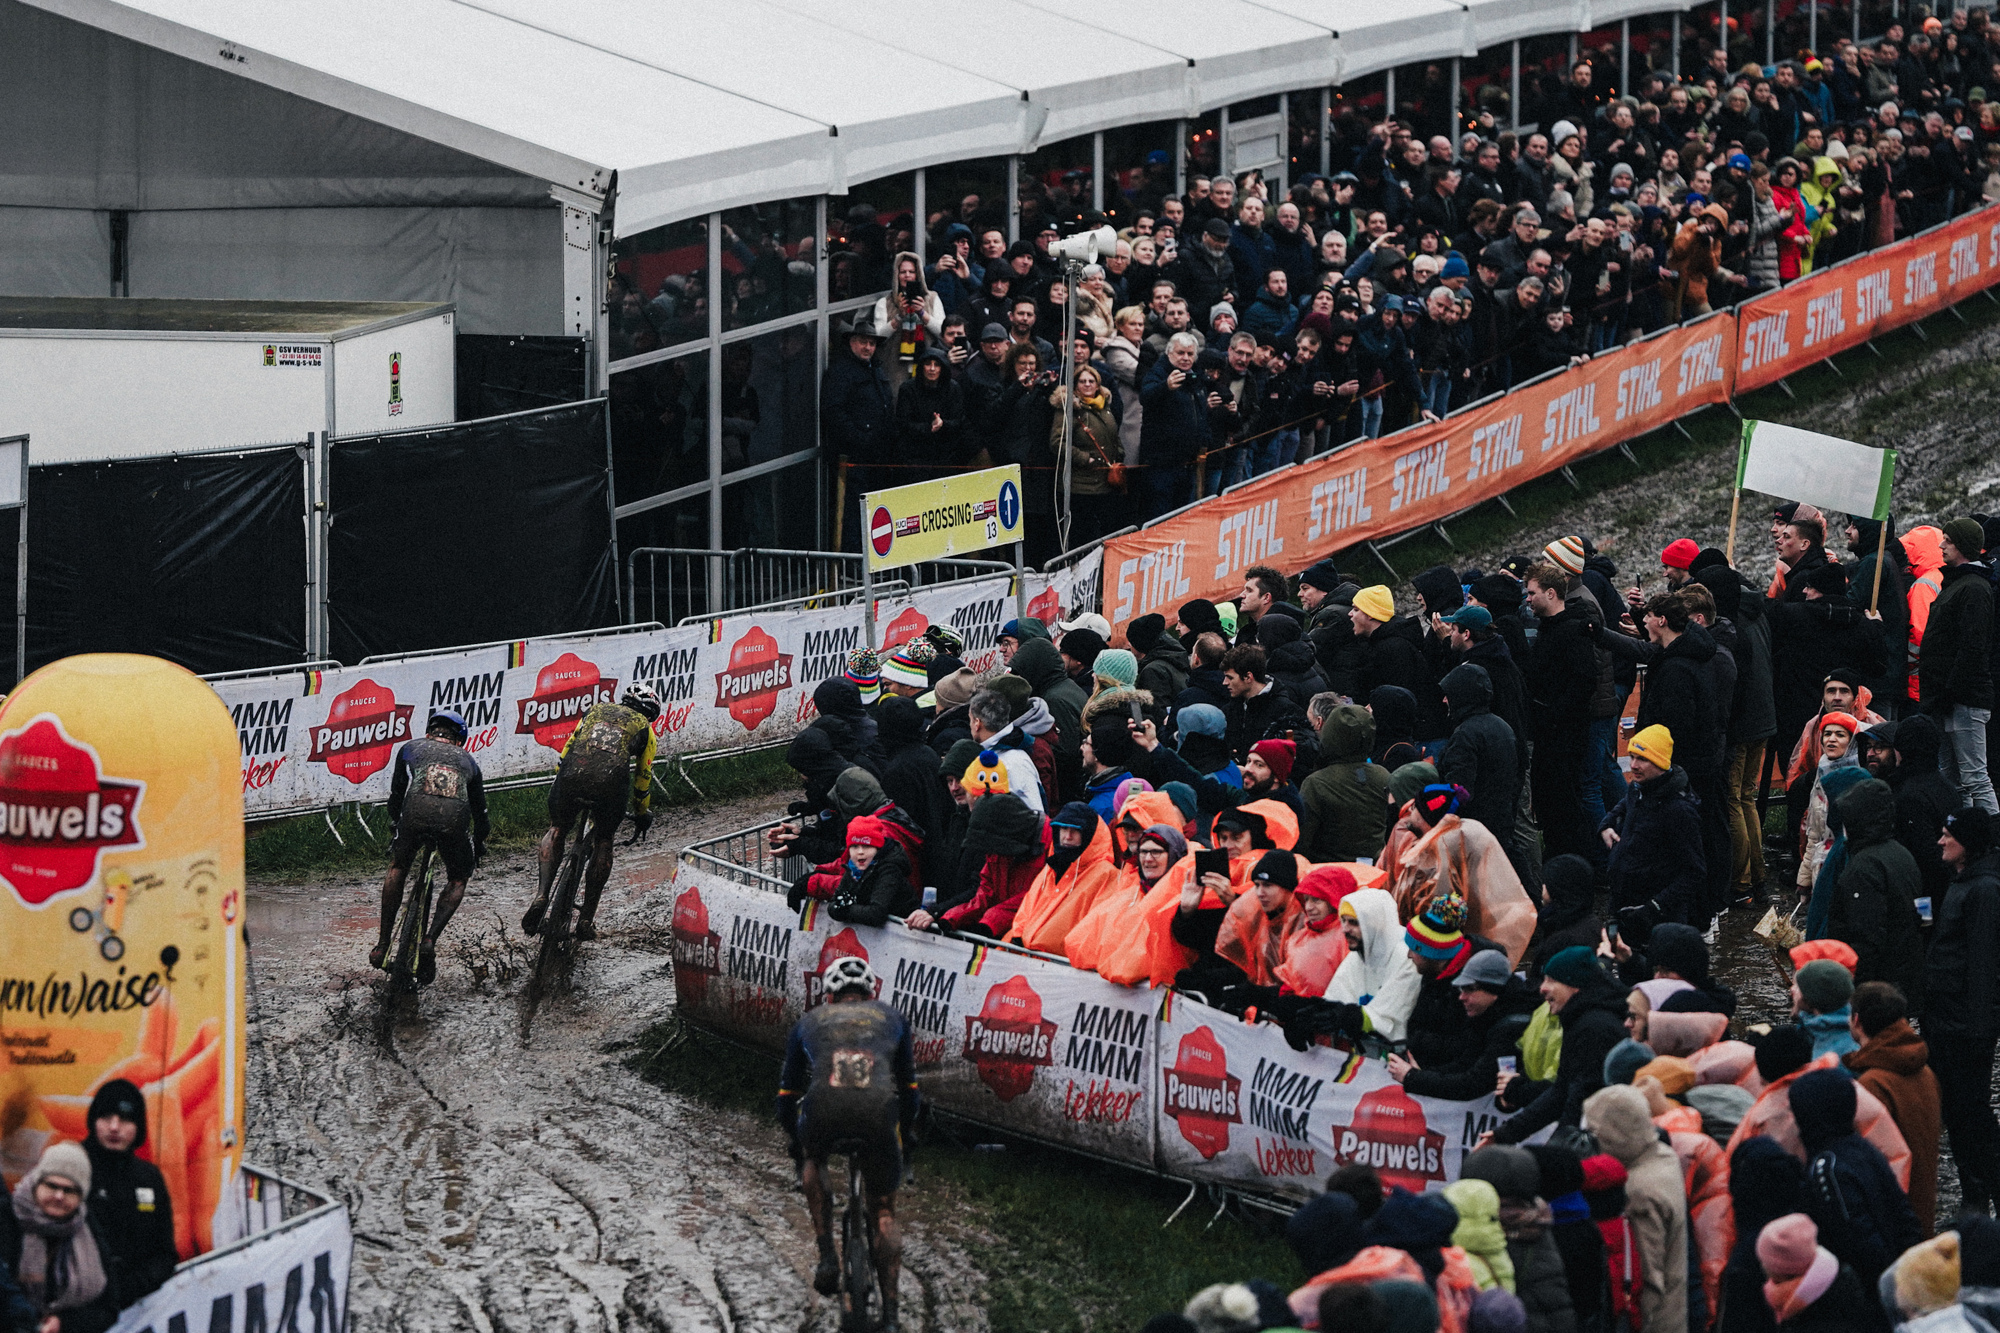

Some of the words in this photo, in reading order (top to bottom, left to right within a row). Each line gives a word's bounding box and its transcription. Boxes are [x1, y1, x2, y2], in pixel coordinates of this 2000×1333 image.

[1904, 252, 1937, 305] STIHL
[1948, 233, 1979, 286] STIHL
[1804, 288, 1845, 348] STIHL
[1857, 268, 1892, 326] STIHL
[1742, 310, 1790, 372] STIHL
[1677, 334, 1724, 396] STIHL
[1616, 358, 1662, 421] STIHL
[1542, 383, 1599, 452] STIHL
[1467, 414, 1523, 481] STIHL
[1390, 440, 1450, 511] STIHL
[922, 502, 971, 533] CROSSING
[1308, 467, 1372, 542] STIHL
[987, 522, 997, 539] 13
[1215, 499, 1283, 580] STIHL
[1114, 539, 1190, 624] STIHL
[744, 644, 764, 653] SAUCES
[804, 626, 858, 656] MMM
[899, 623, 918, 632] SAUCES
[959, 623, 999, 651] MM
[555, 671, 581, 679] SAUCES
[633, 647, 698, 680] MMM
[720, 660, 788, 699] Pauwels
[350, 696, 376, 706] SAUCES
[430, 670, 504, 707] MMM
[523, 684, 610, 726] Pauwels
[632, 673, 695, 702] MM
[316, 711, 406, 754] Pauwels
[426, 698, 501, 733] MM
[240, 726, 288, 756] MM
[730, 915, 792, 959] MMM
[728, 947, 787, 991] MMM
[894, 958, 957, 1002] MMM
[1002, 994, 1026, 1008] SAUCES
[969, 1020, 1049, 1058] Pauwels
[1072, 1002, 1148, 1048] MMM
[1065, 1035, 1142, 1084] MMM
[1192, 1046, 1212, 1061] SAUCES
[1168, 1073, 1236, 1115] Pauwels
[1252, 1057, 1324, 1110] MMM
[1250, 1091, 1310, 1143] MMM
[1376, 1104, 1405, 1117] SAUCES
[1339, 1131, 1438, 1173] Pauwels
